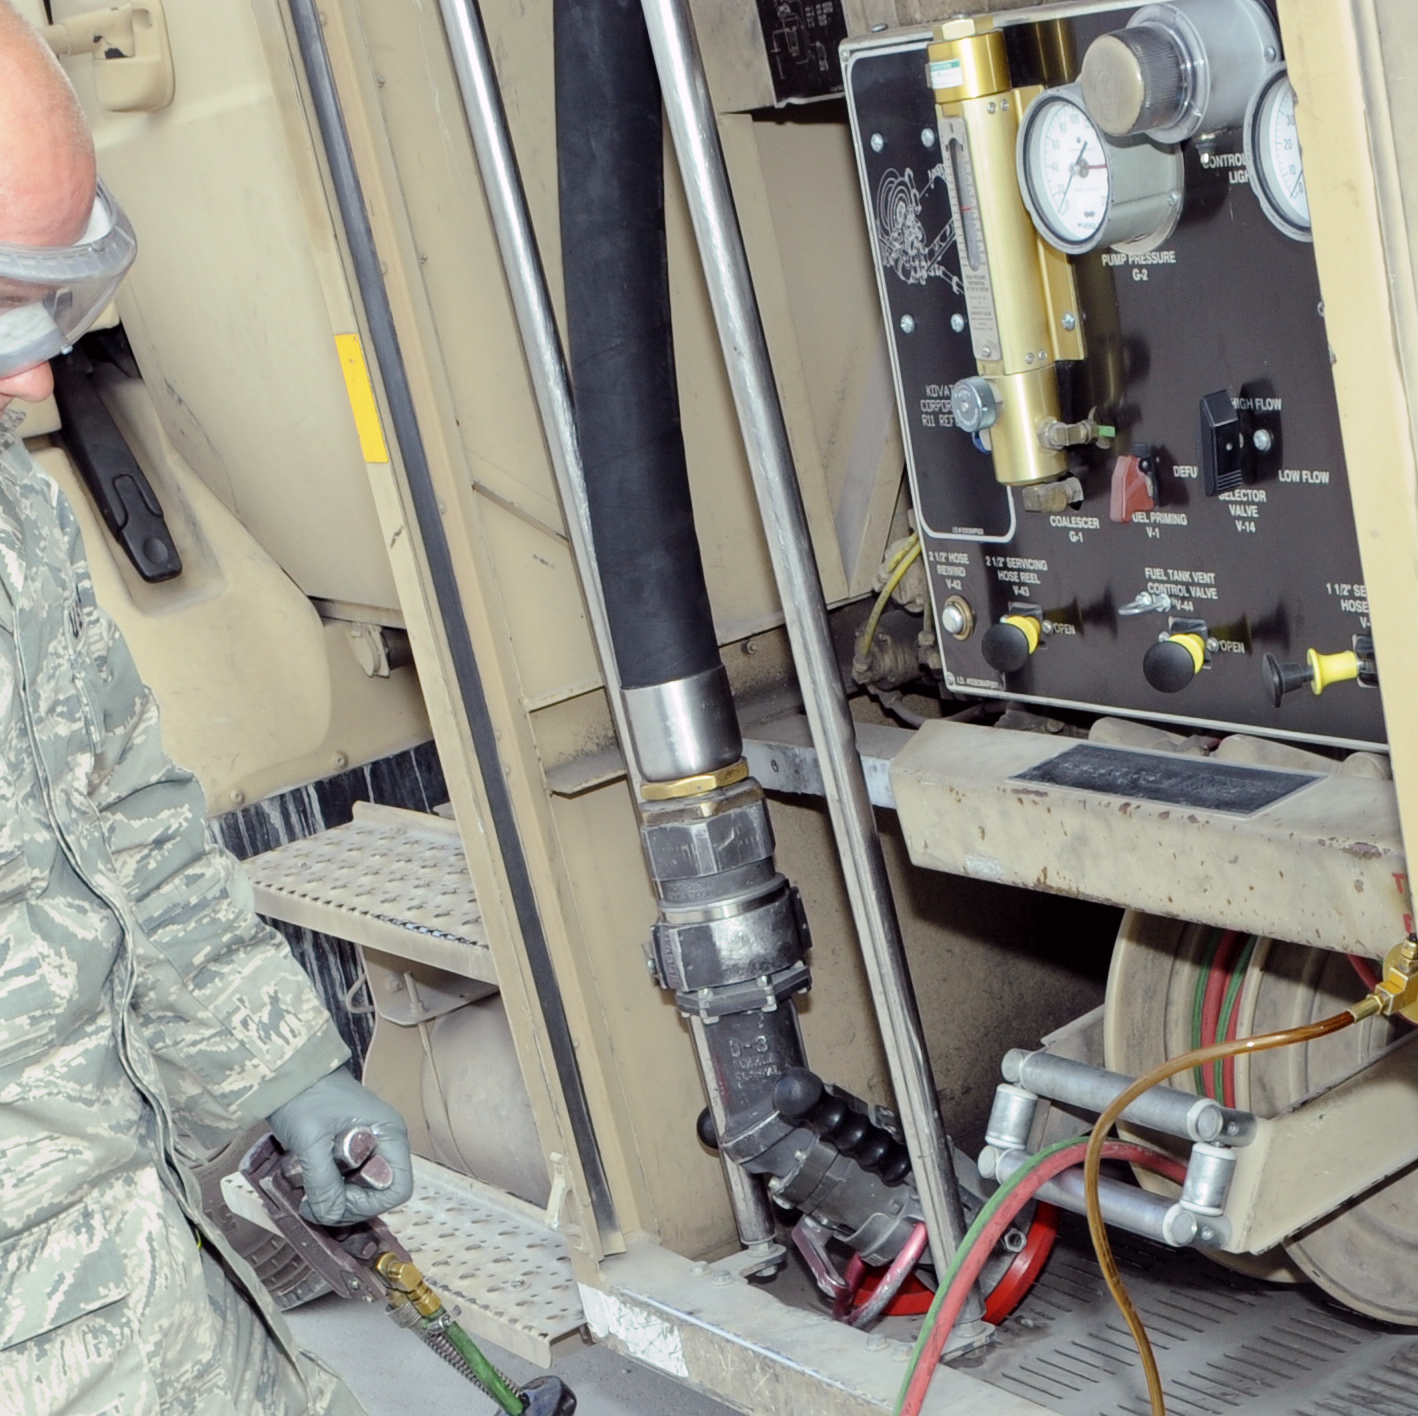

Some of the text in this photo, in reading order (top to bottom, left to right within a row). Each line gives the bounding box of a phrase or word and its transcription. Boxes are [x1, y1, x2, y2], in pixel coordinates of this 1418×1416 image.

[1101, 250, 1176, 267] PUMP PRESSURE
[1132, 268, 1148, 281] G-2
[1255, 397, 1282, 411] FLOW
[938, 414, 955, 428] REF
[1173, 465, 1198, 478] DEFU
[1278, 469, 1329, 484] LOW FLOW
[1218, 488, 1267, 502] SELECTOR
[1229, 504, 1259, 518] VALVE
[1050, 515, 1100, 529] COALESCER
[1132, 511, 1188, 526] UEL PRIMING
[1145, 526, 1160, 539] V-1
[1235, 519, 1256, 533] V-14
[1069, 531, 1084, 543] G-1
[948, 552, 970, 565] HOSE
[1006, 557, 1048, 571] SERVICING
[936, 565, 966, 578] REWIND
[997, 570, 1041, 585] HOSE REEL
[1144, 567, 1216, 585] FUEL TANK VENT
[945, 578, 962, 591] V-42
[1012, 584, 1030, 597] V-43
[1147, 582, 1218, 600] CONTROL VALVE
[1353, 583, 1367, 597] SE
[1341, 599, 1370, 613] HOSE
[1053, 622, 1076, 635] OPEN
[1359, 616, 1371, 629] V-
[1219, 640, 1245, 654] OPEN
